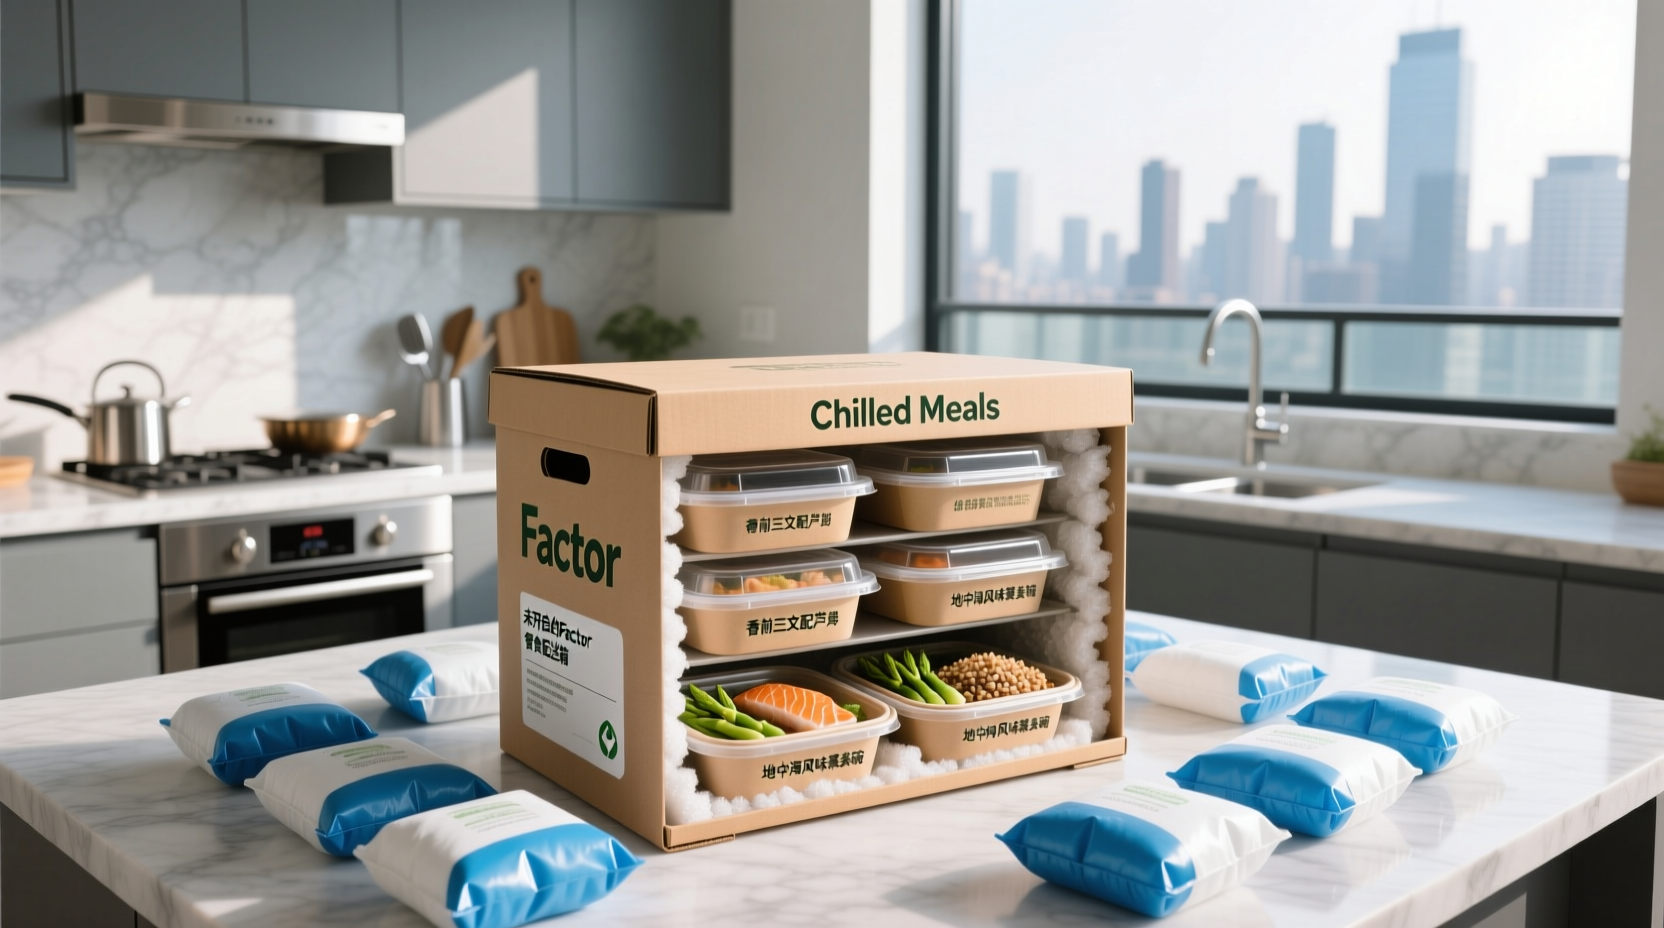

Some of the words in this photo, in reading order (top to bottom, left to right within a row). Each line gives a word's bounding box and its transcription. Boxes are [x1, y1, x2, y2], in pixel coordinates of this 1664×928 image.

[810, 395, 911, 431] Chilled
[919, 392, 1001, 423] Meals
[521, 502, 622, 588] Factor
